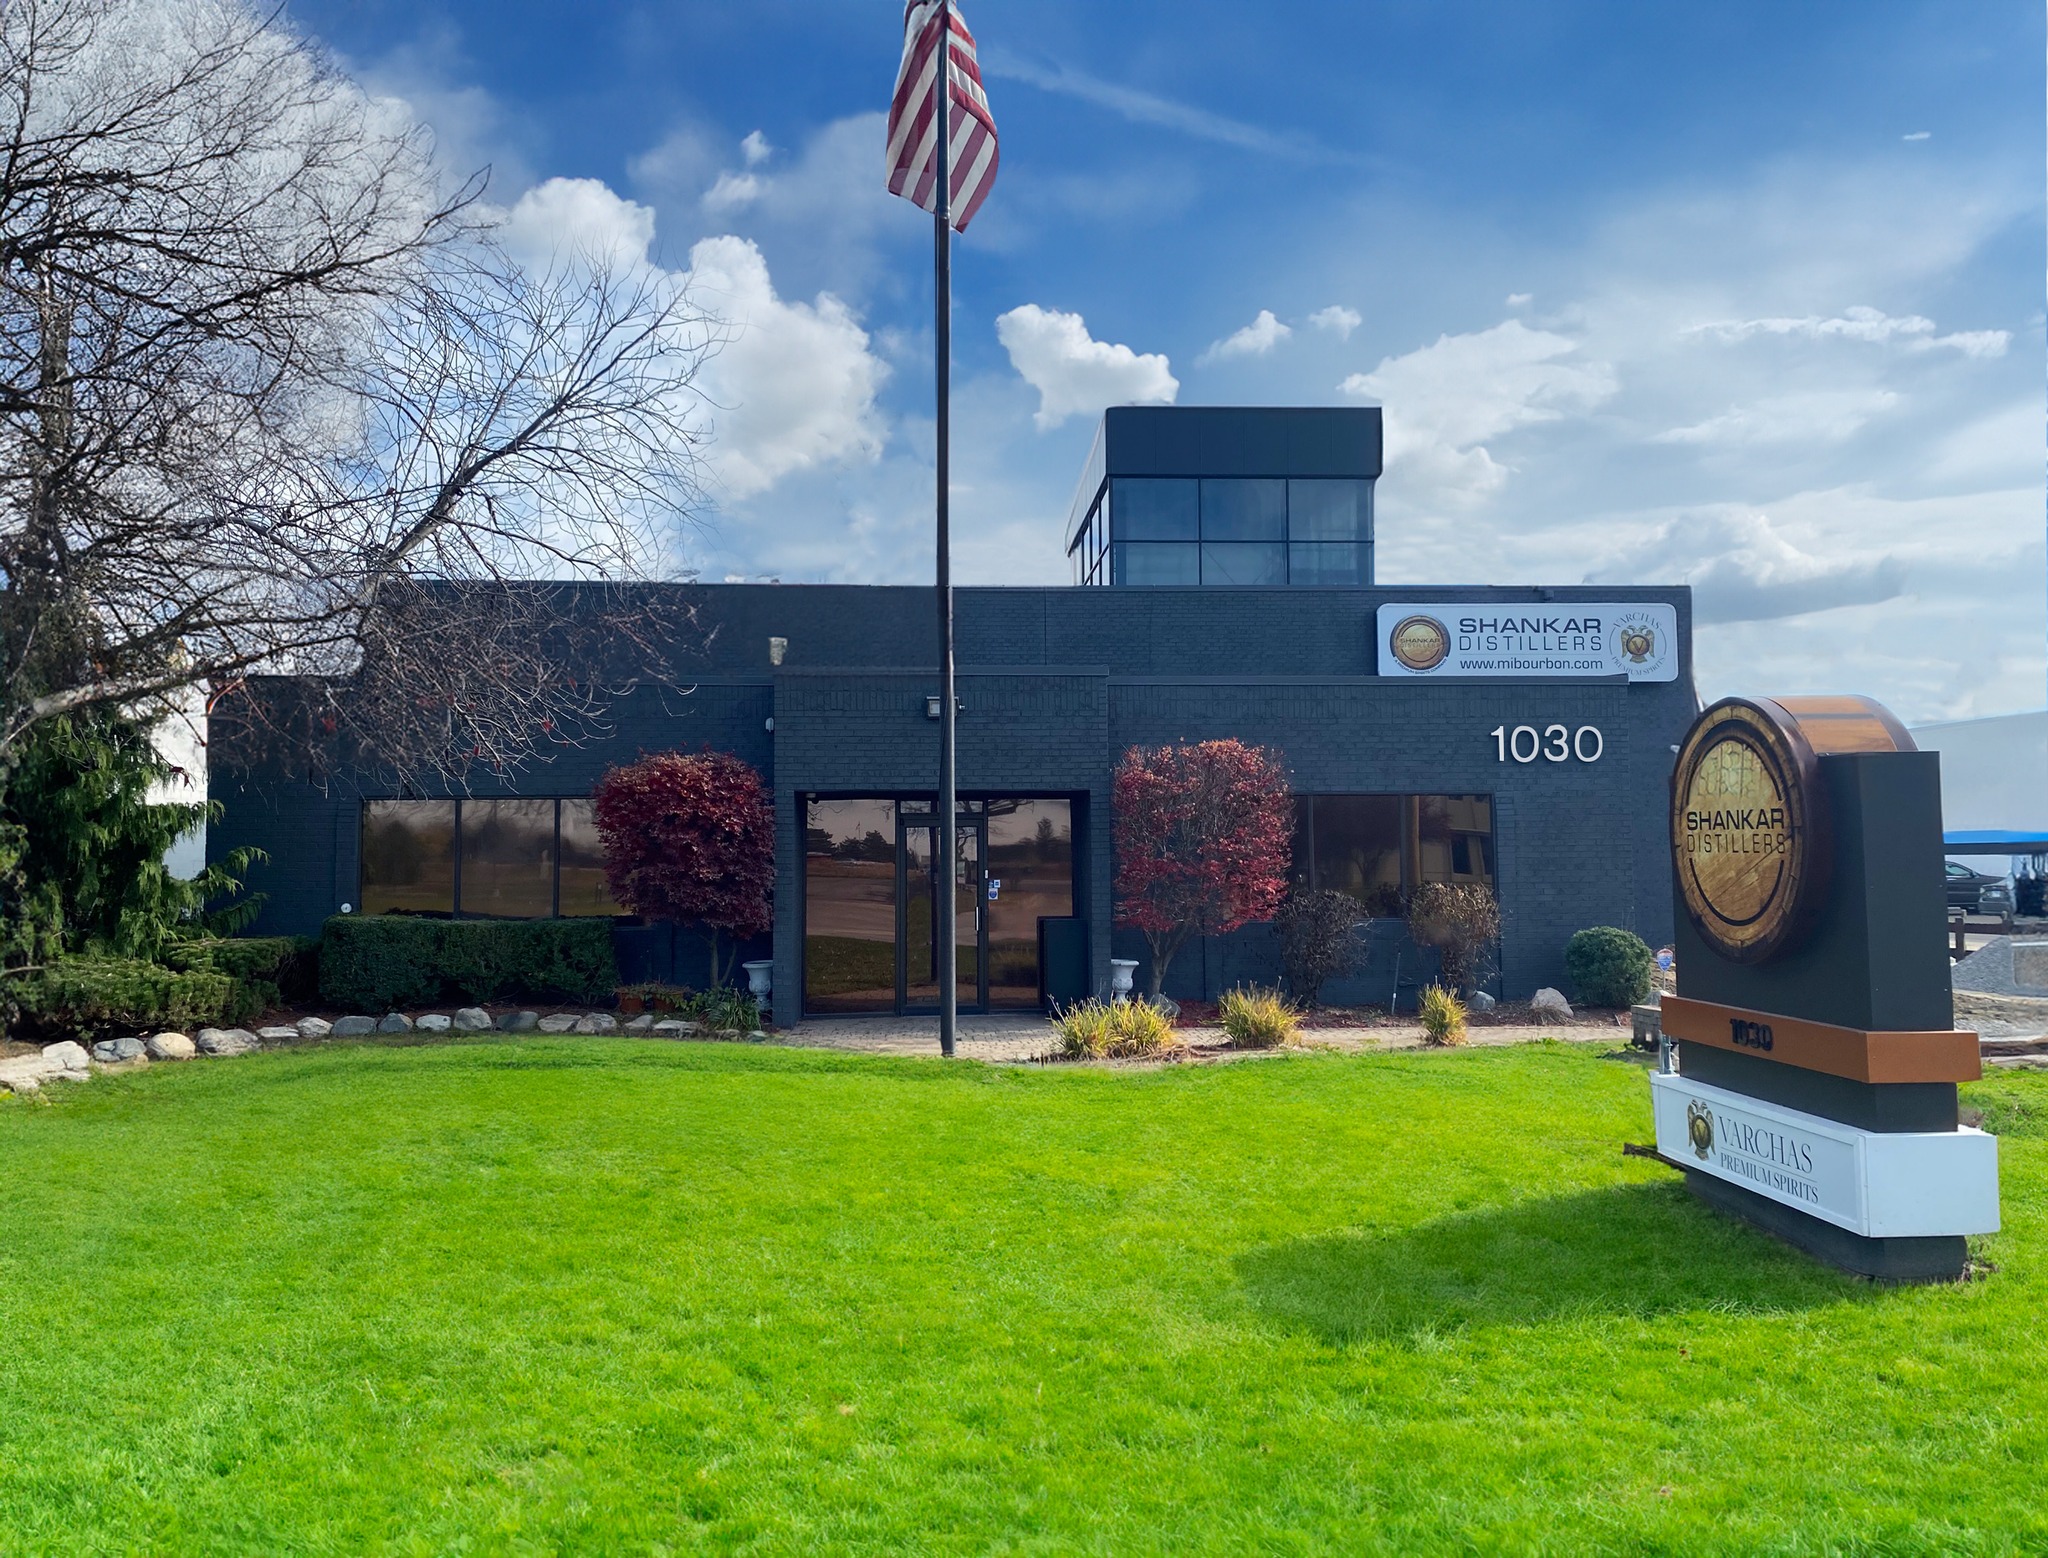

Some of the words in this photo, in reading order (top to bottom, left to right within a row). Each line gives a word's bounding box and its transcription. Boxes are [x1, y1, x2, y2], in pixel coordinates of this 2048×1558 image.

[1459, 618, 1602, 633] SHANKAR
[1459, 635, 1602, 651] DISTILLERS
[1459, 657, 1603, 669] www.mibourbon.com
[1490, 724, 1603, 763] 1030
[1686, 808, 1785, 831] SHANKAR
[1687, 833, 1785, 854] DISTILLERS
[1729, 1018, 1773, 1051] 1030
[1718, 1115, 1813, 1174] VARCHAS
[1720, 1152, 1772, 1186] PREMIUM
[1773, 1172, 1819, 1204] SPIRITS
